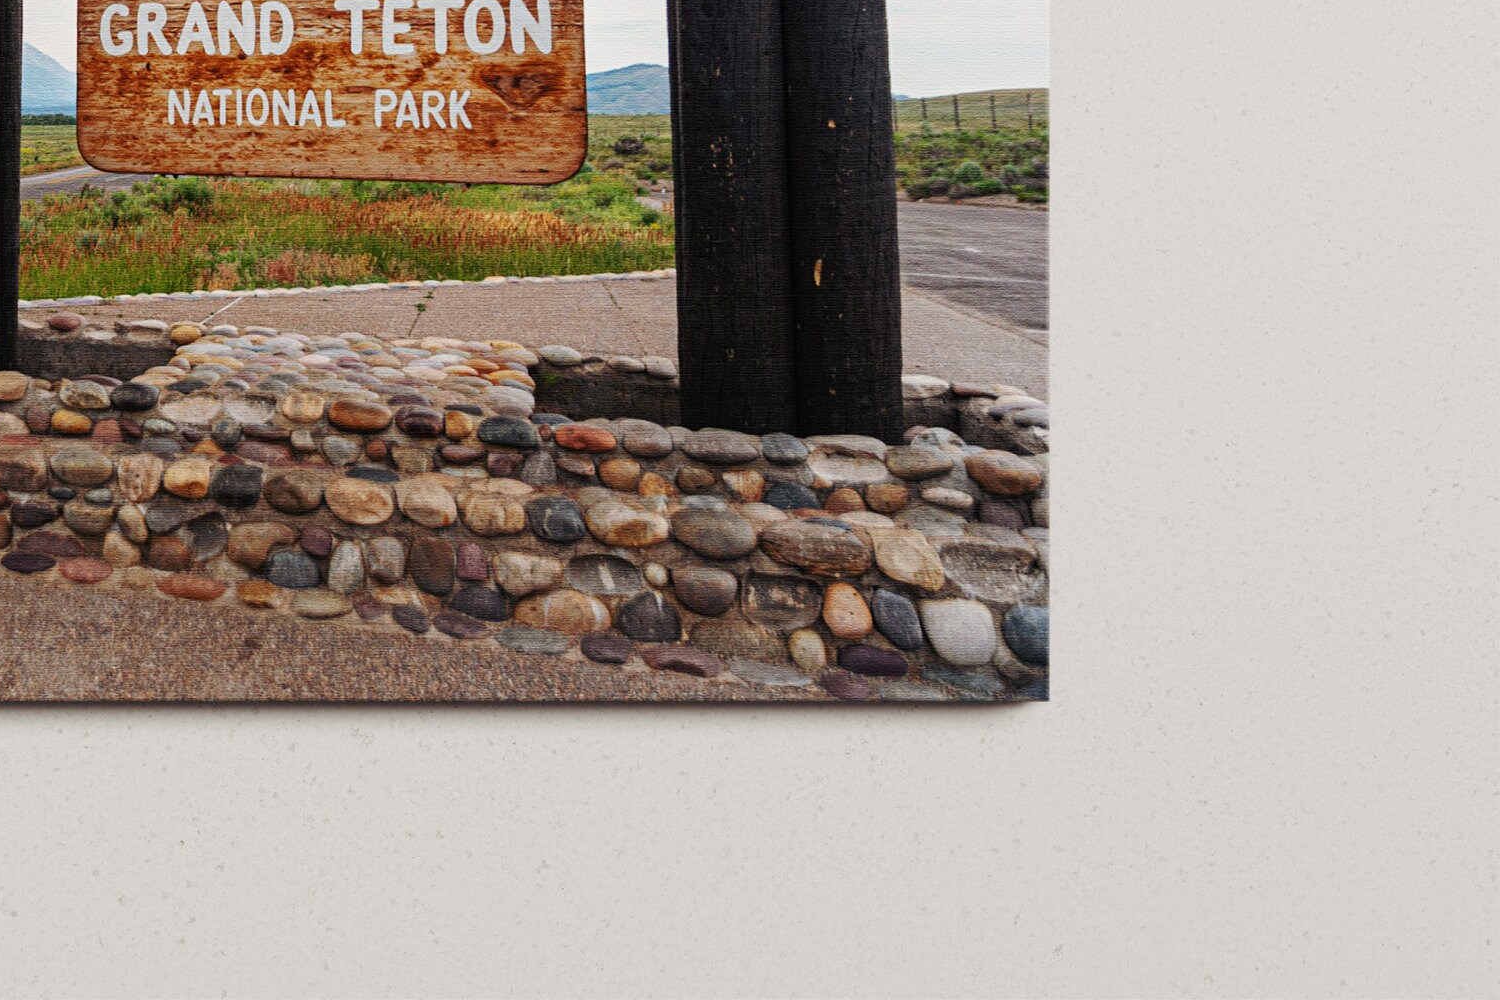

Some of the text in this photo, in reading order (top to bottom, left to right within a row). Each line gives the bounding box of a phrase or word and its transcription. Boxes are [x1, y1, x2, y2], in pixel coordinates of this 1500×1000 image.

[100, 0, 294, 56] GRAND
[167, 87, 473, 129] NATIONAL PARK
